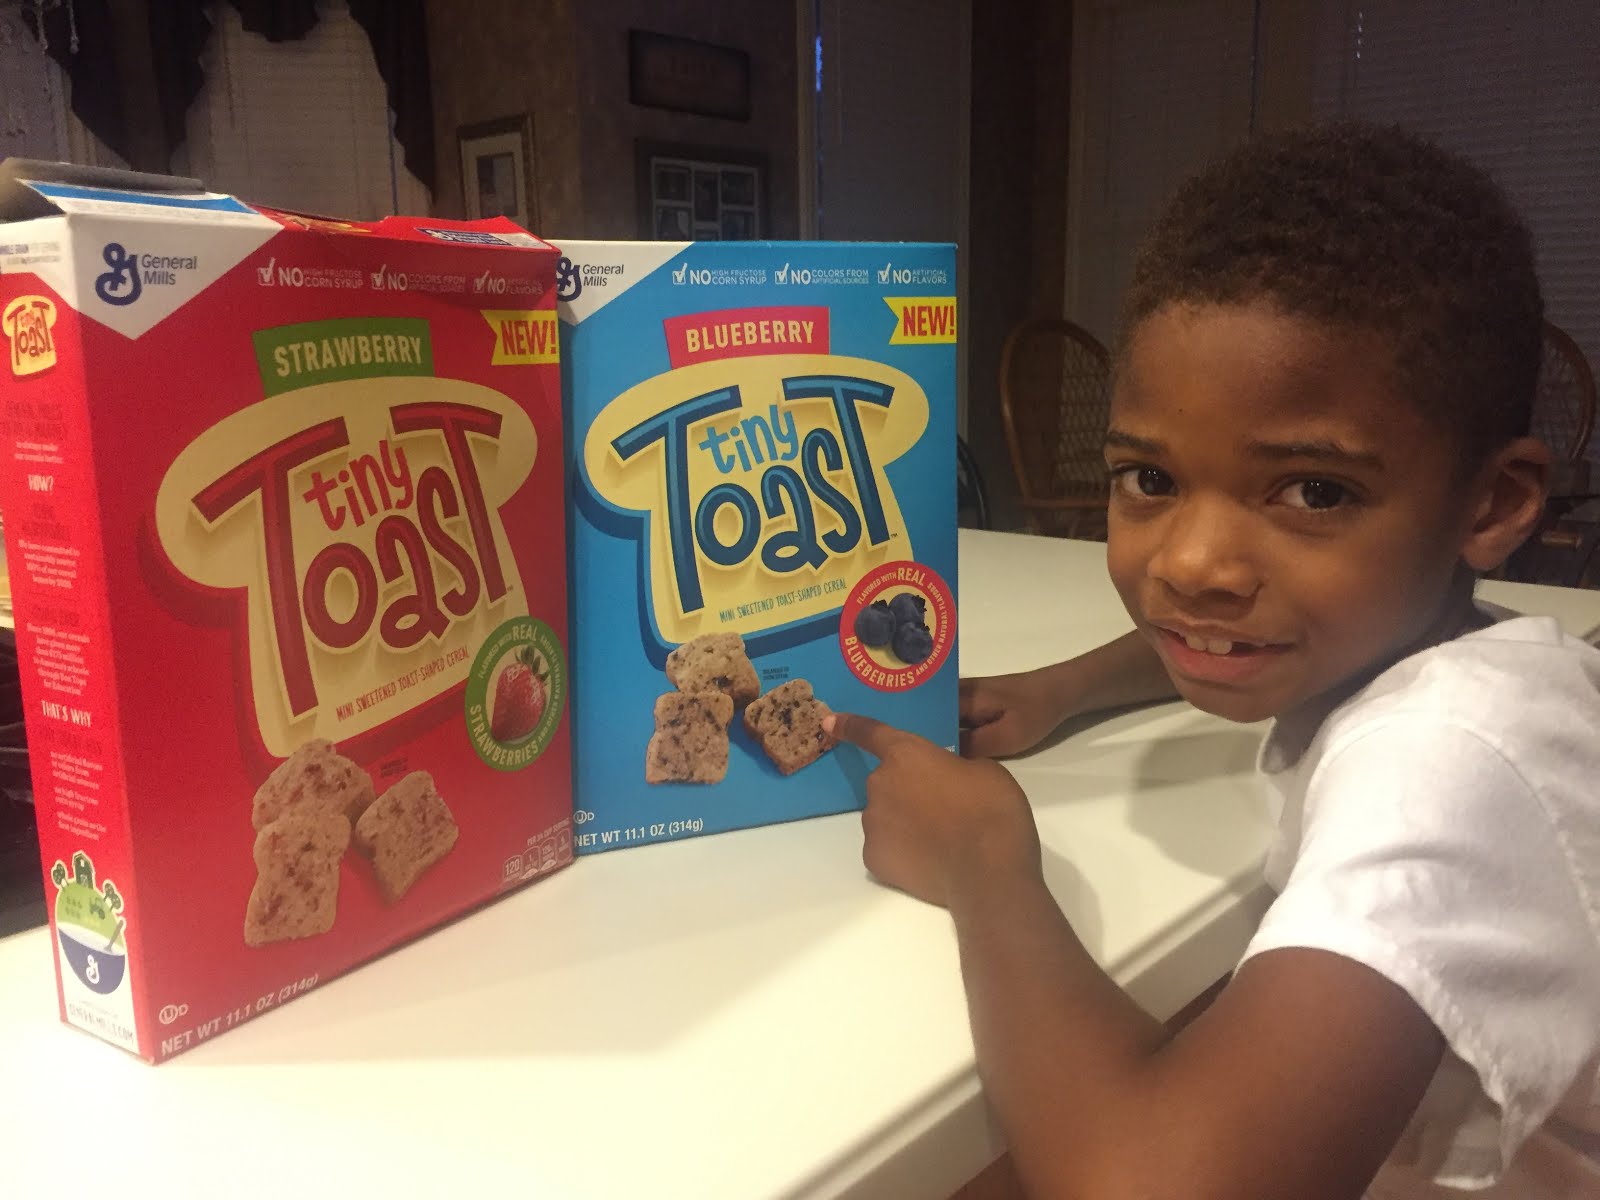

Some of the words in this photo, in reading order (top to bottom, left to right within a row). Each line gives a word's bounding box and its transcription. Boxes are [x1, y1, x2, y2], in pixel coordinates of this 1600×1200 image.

[141, 253, 198, 270] General
[582, 263, 624, 275] General
[144, 271, 176, 285] Mills
[278, 266, 304, 288] NO
[304, 276, 333, 288] CORN
[335, 278, 364, 289] SYRUP
[387, 271, 409, 291] NO
[487, 277, 506, 294] NO
[583, 276, 608, 287] Mills
[690, 269, 712, 285] NO
[711, 276, 737, 285] CORN
[739, 276, 767, 285] SYRUP
[790, 269, 811, 285] NO
[811, 269, 845, 278] COLORS
[846, 269, 869, 278] FROM
[893, 269, 912, 285] NO
[912, 276, 948, 285] FLAVORS
[902, 305, 956, 337] NEW!
[500, 319, 557, 356] NEW!
[685, 319, 815, 353] BLUEBERRY
[273, 334, 423, 378] STRAWBERRY
[698, 403, 800, 475] tiny
[303, 438, 415, 532] tiny
[857, 578, 882, 605] FLAVORED
[881, 571, 898, 583] WITH
[898, 567, 926, 586] REAL
[926, 582, 947, 611] FLAVORS
[719, 607, 736, 623] MINI
[737, 598, 774, 619] SWEETENED
[776, 584, 822, 607] TOAST-SHAPED
[823, 577, 848, 595] CEREAL
[512, 623, 539, 642] REAL
[938, 609, 948, 645] NATURAL
[844, 635, 915, 687] BLUEBERRIES
[928, 643, 944, 665] OTHER
[915, 663, 929, 676] AND
[336, 702, 355, 723] MINI
[356, 681, 398, 713] SWEETENED
[397, 656, 445, 692] TOAST-SHAPED
[446, 645, 470, 668] CEREAL
[41, 700, 69, 722] THAT'S
[69, 707, 92, 728] WHY
[470, 703, 540, 766] STRAWBERRIES
[574, 833, 598, 847] NET
[601, 830, 621, 844] WT
[624, 826, 646, 841] 11.1
[650, 823, 665, 837] OZ
[668, 817, 704, 836] (314g)
[504, 858, 520, 876] 120
[161, 1030, 194, 1056] NET
[197, 1017, 222, 1040] WT
[226, 1004, 251, 1026] 11.1
[255, 992, 275, 1012] OZ
[278, 972, 319, 1003] (314g)
